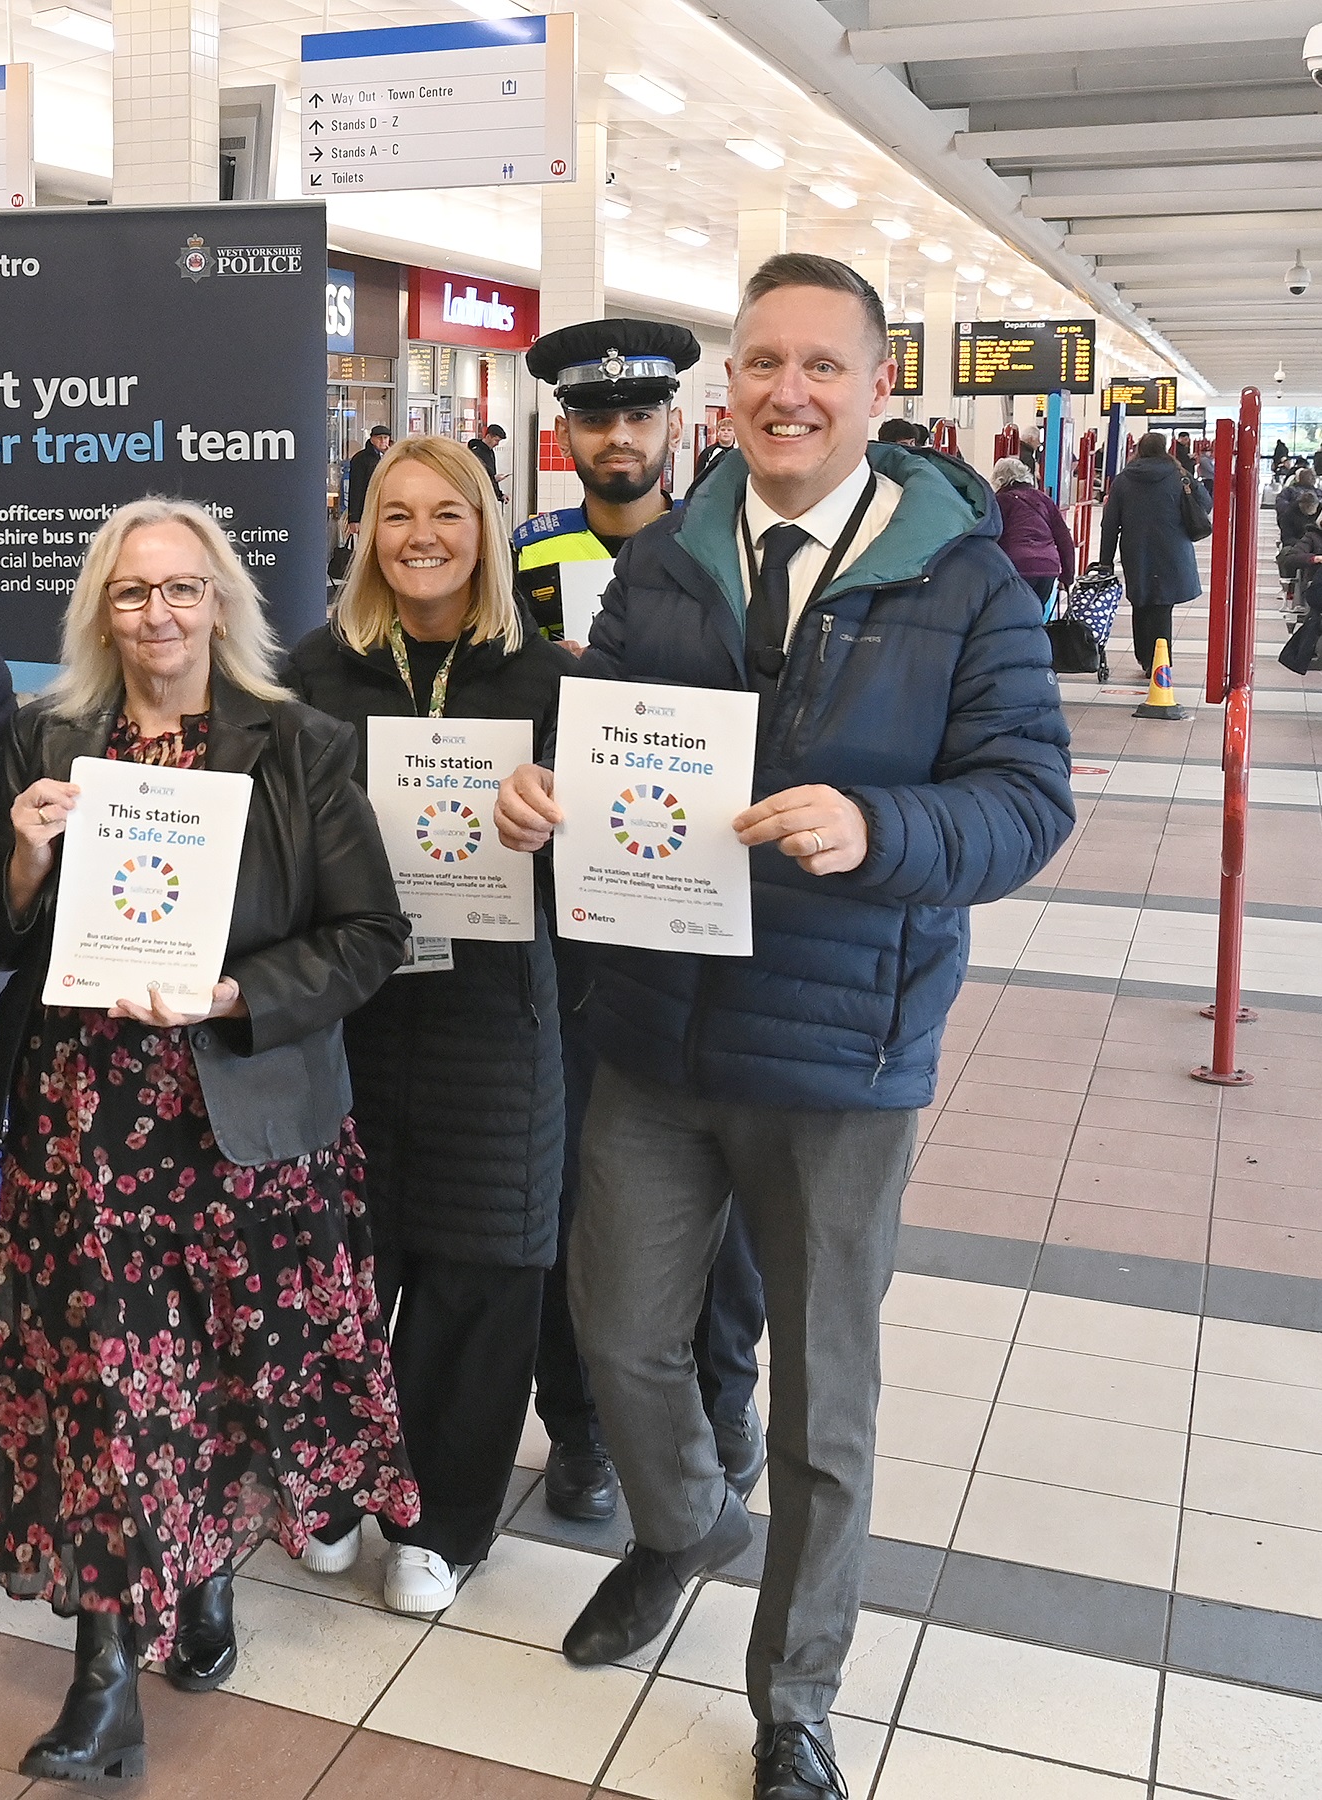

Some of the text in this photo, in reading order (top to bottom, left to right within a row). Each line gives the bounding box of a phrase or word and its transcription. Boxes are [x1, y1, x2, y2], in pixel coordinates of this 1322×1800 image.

[331, 86, 453, 106] Way Out Town Centre
[331, 116, 399, 131] Stands D Z
[331, 144, 399, 159] Stands A C
[332, 173, 364, 184] Toilets
[246, 248, 302, 256] YORKSHIRE
[217, 256, 302, 274] POLICE
[443, 282, 515, 332] Ladbrokes
[1004, 322, 1045, 330] Departures
[32, 375, 138, 419] your
[33, 420, 164, 464] travel
[177, 424, 295, 462] team
[68, 503, 118, 520] worki
[203, 502, 233, 518] the
[43, 528, 73, 544] bus
[241, 526, 289, 542] crime
[32, 551, 85, 568] behavi
[247, 550, 276, 565] the
[0, 574, 31, 592] and
[36, 579, 76, 595] supp
[602, 726, 705, 750] This station
[405, 755, 492, 769] This station
[592, 748, 713, 775] is a Safe Zone
[398, 774, 500, 789] is a Safe Zone
[109, 804, 199, 824] This station
[99, 823, 205, 845] is a Safe Zone
[589, 866, 603, 874] Bus
[604, 868, 630, 876] station
[632, 870, 650, 879] staff
[665, 875, 682, 883] here
[694, 878, 711, 886] help
[605, 877, 628, 885] you're
[629, 879, 655, 889] feeling
[657, 883, 682, 892] unsafe
[703, 887, 718, 895] risk
[588, 913, 615, 923] Metro
[77, 978, 100, 987] Metro
